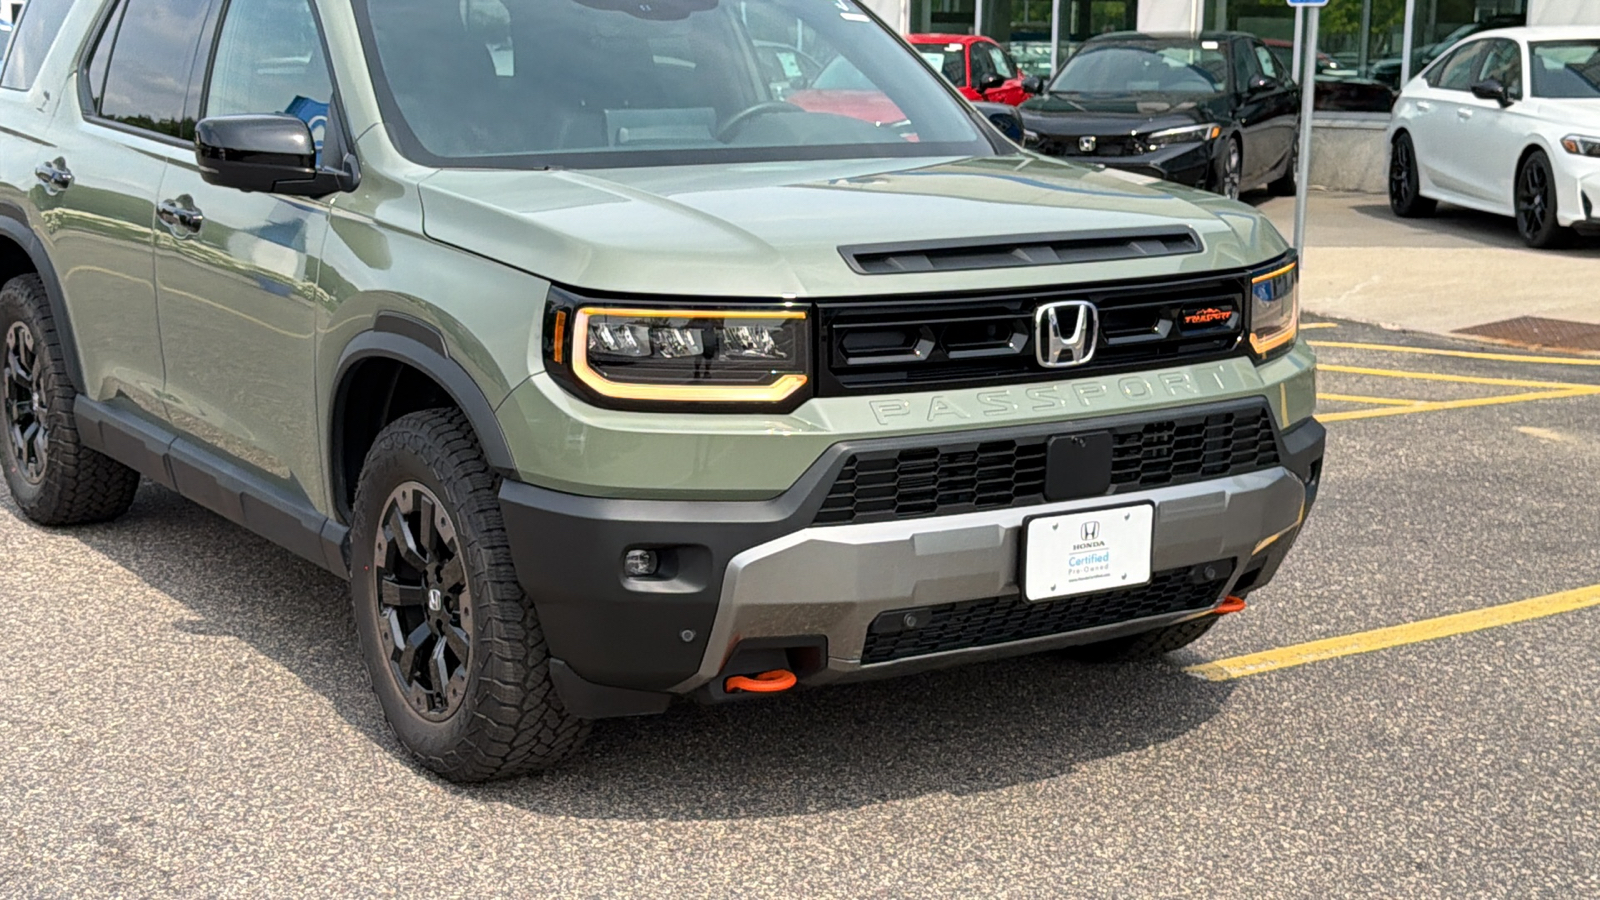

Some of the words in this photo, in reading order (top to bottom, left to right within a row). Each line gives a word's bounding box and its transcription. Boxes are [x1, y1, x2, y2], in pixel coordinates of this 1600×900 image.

[869, 364, 1225, 425] PASSPORT
[1073, 541, 1105, 550] HONDA
[1068, 551, 1109, 567] Certified
[1068, 563, 1109, 575] Pre-Owned
